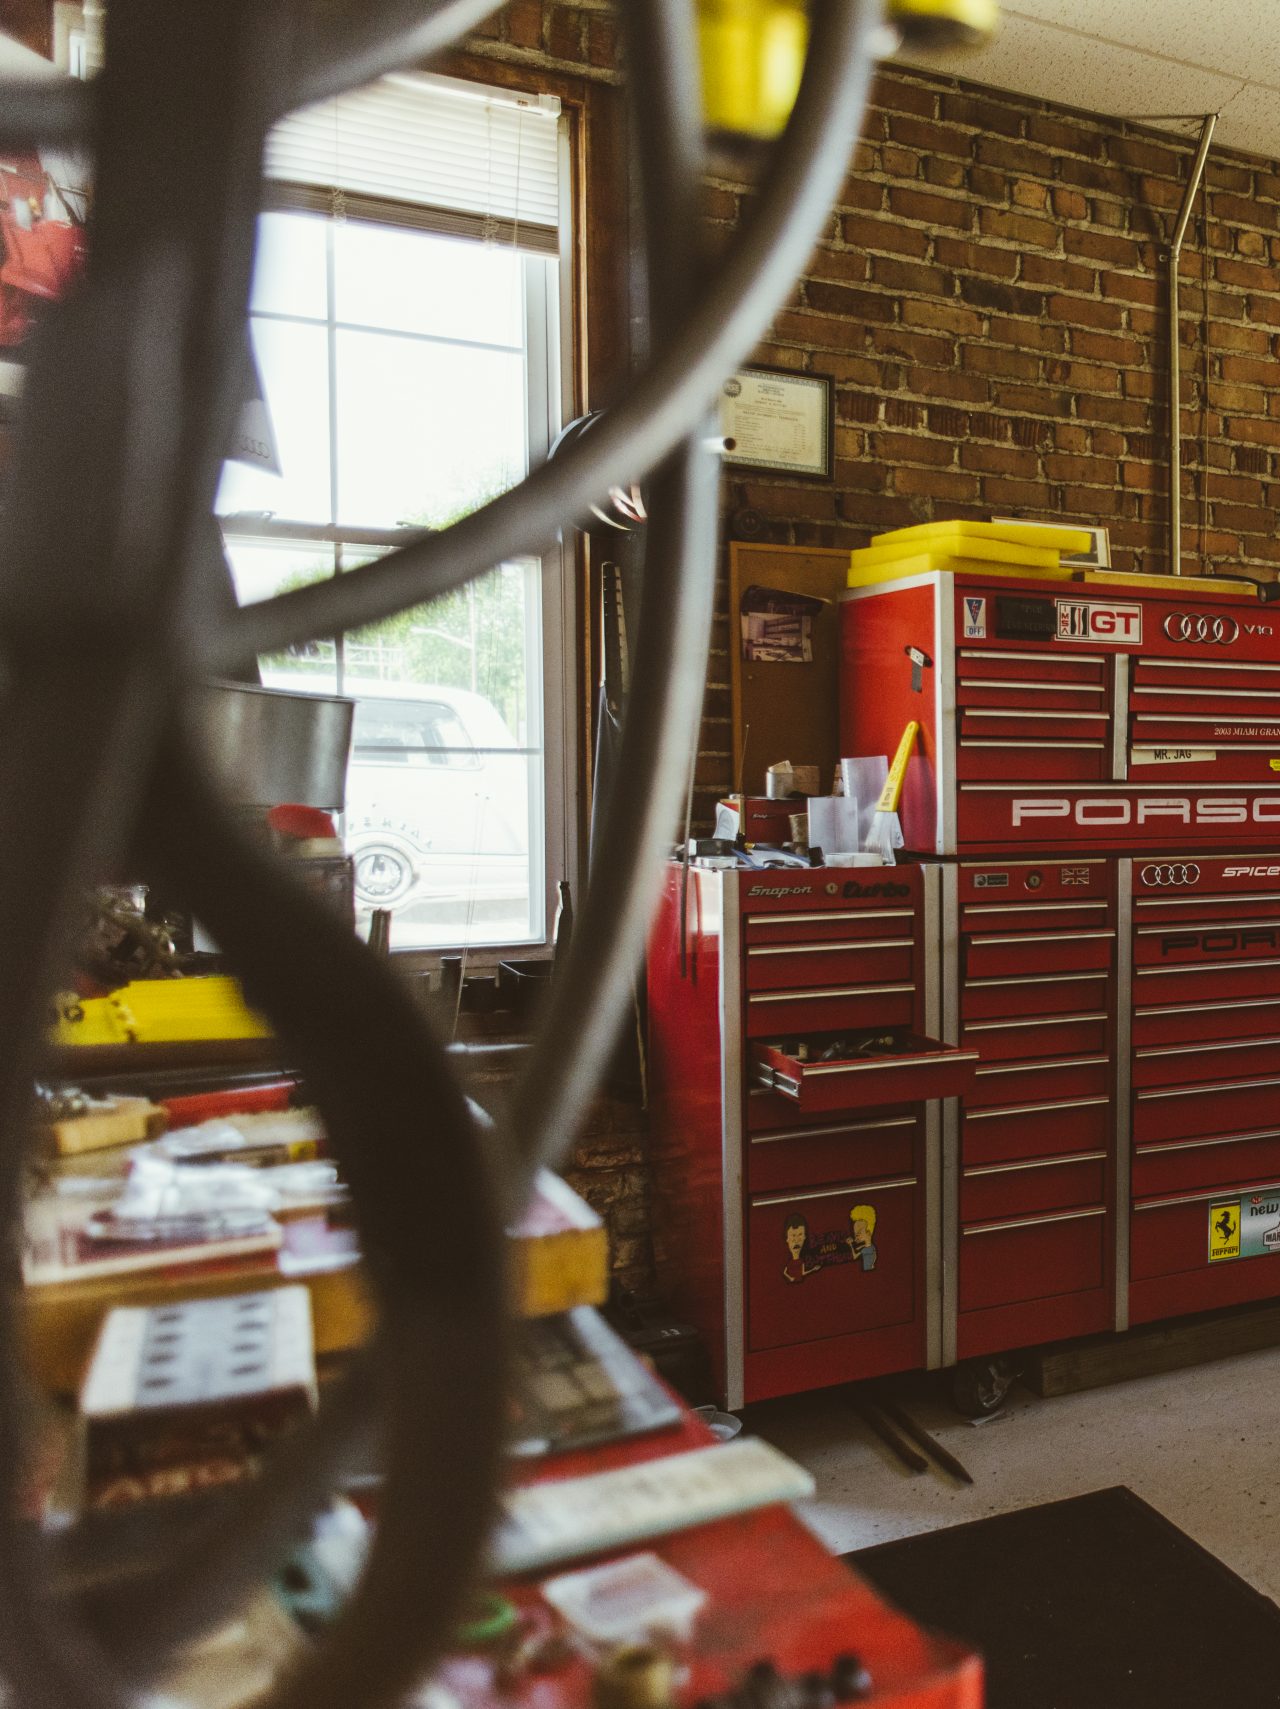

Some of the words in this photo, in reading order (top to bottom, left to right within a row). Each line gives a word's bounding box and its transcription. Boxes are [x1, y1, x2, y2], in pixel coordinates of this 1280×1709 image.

[1060, 605, 1071, 635] IMSA
[1090, 610, 1139, 635] GT
[967, 627, 982, 636] OFF
[1243, 624, 1274, 636] V10
[1214, 728, 1232, 736] 2003
[1233, 728, 1258, 736] MIAMI
[1153, 749, 1171, 761] MR.
[1173, 748, 1192, 760] JAG
[1221, 866, 1280, 878] SPICE
[748, 885, 813, 898] Snap-on
[1211, 1245, 1239, 1257] Ferrari
